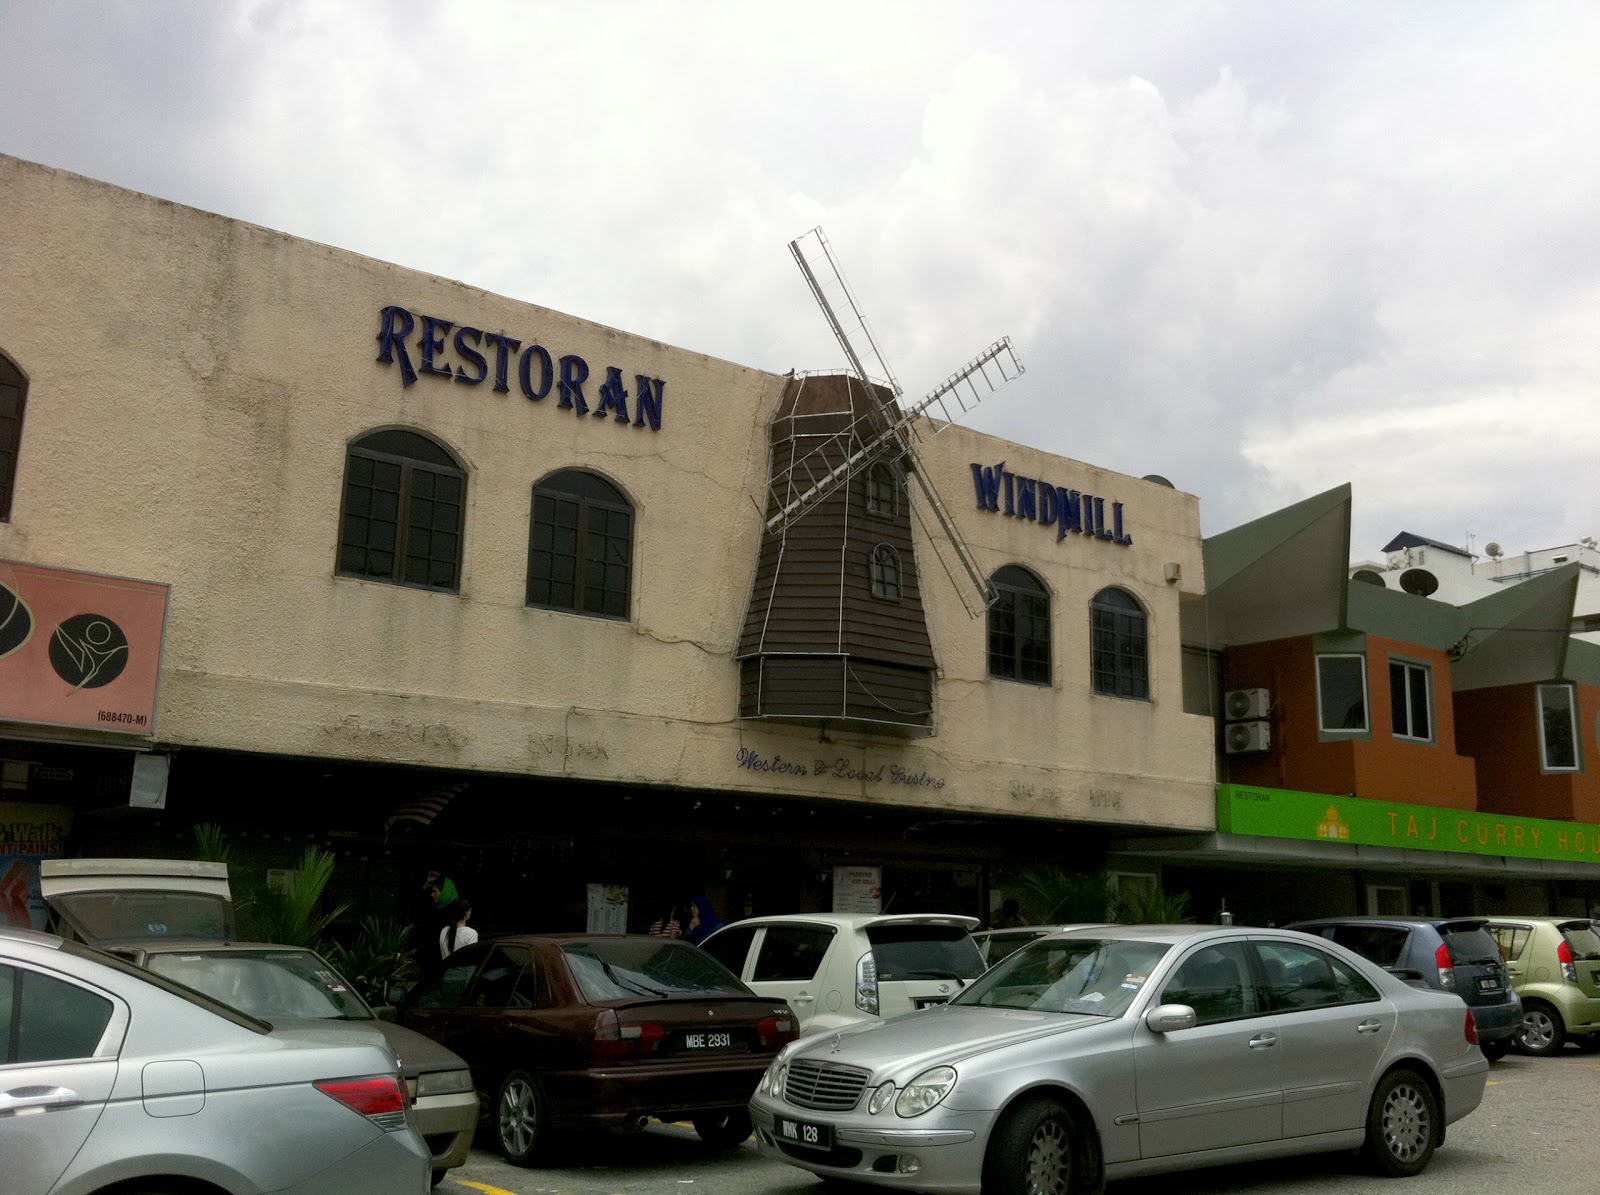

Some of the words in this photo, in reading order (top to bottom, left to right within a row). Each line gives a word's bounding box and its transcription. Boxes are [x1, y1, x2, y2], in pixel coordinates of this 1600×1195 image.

[375, 305, 667, 431] RESTORAN
[970, 460, 1133, 544] WINDMILL
[98, 710, 147, 726] (688470-M)
[736, 748, 807, 776] Western
[831, 758, 885, 782] Local
[1235, 790, 1271, 802] RESTORAN
[1387, 811, 1438, 841] TAJ
[1457, 819, 1542, 849] CURRY
[686, 1034, 706, 1048] MBE
[708, 1033, 731, 1047] 2931
[782, 1120, 798, 1140] WMK
[802, 1124, 818, 1143] 128
